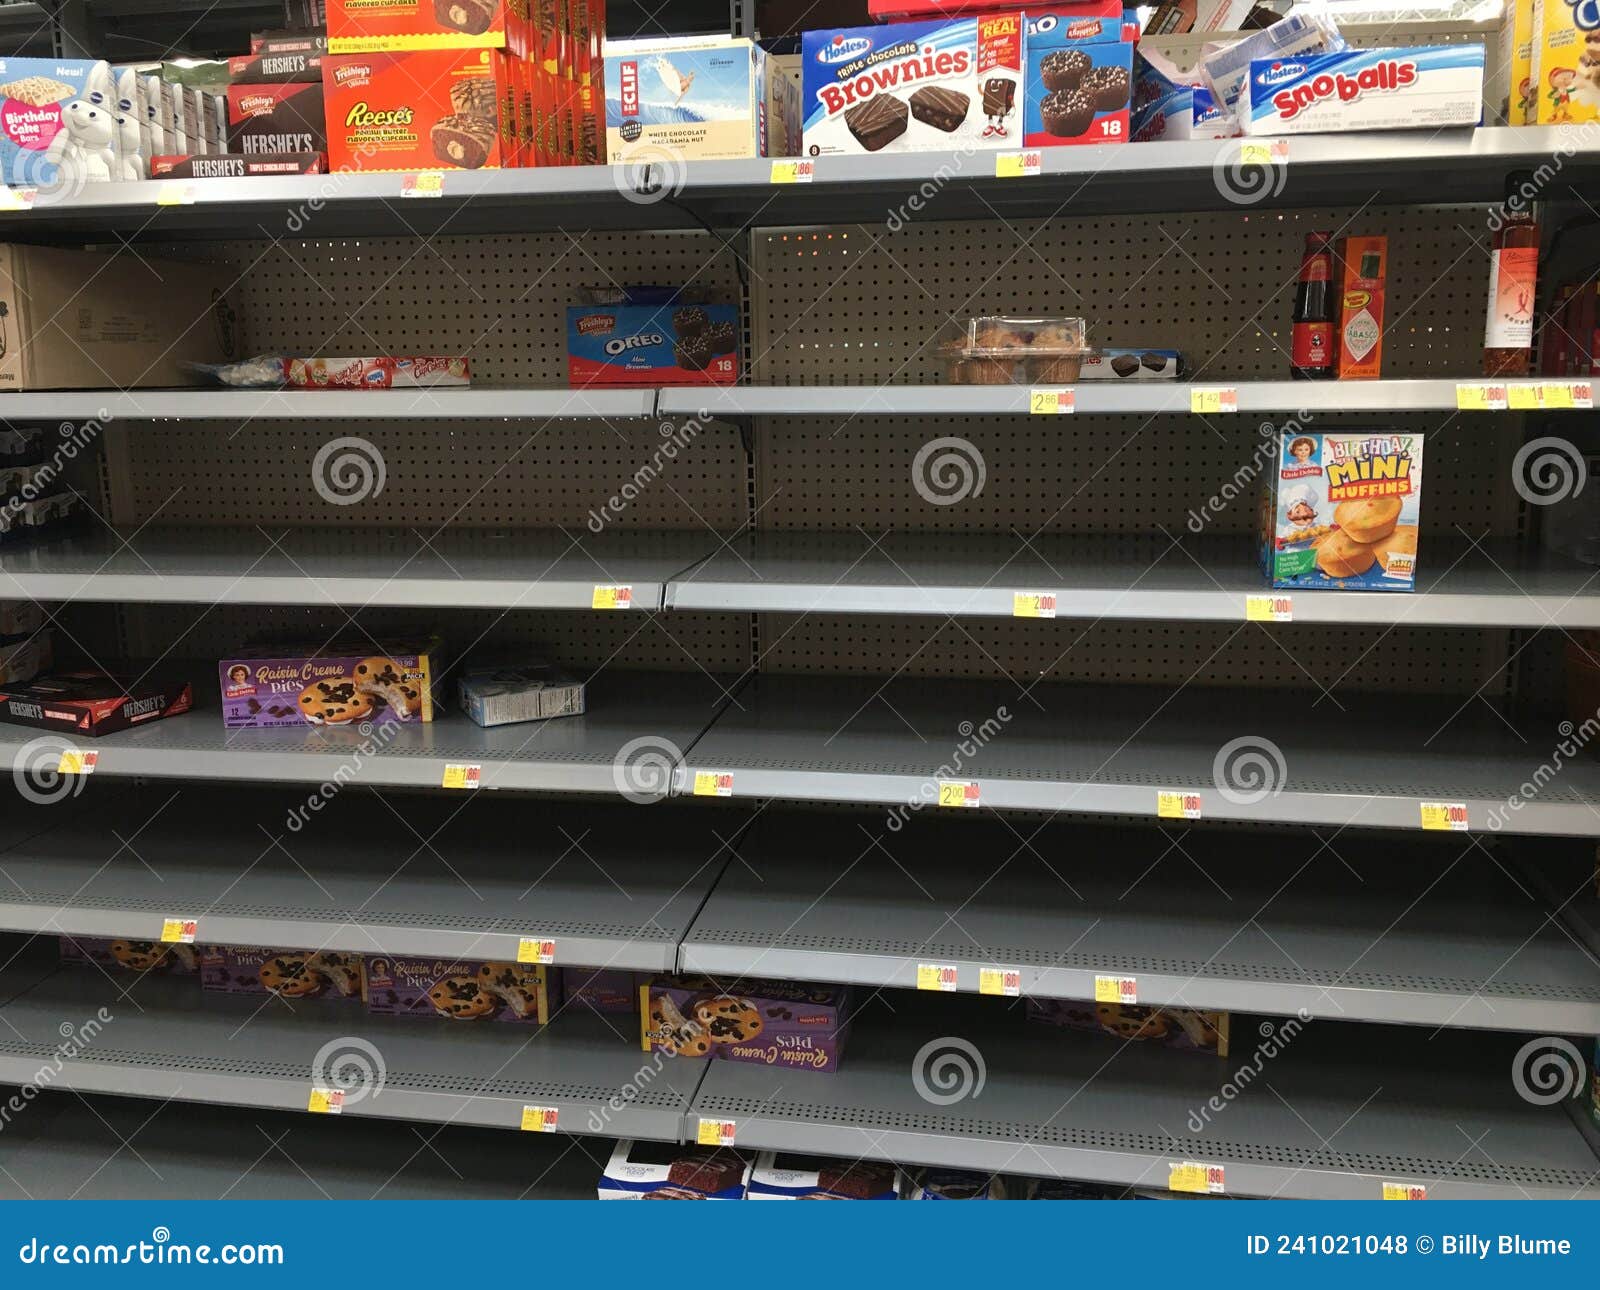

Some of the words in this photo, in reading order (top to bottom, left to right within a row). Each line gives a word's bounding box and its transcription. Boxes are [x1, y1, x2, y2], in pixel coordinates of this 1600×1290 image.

[984, 21, 1018, 37] REAL
[480, 51, 490, 64] 6
[825, 39, 868, 61] Hostess
[56, 67, 83, 76] New!
[262, 56, 305, 75] HERSHEY'S
[1263, 64, 1303, 83] Hostess
[820, 47, 968, 115] Brownies
[5, 110, 59, 124] Birthday
[346, 102, 414, 127] Reese's
[10, 123, 39, 134] Cake
[1101, 120, 1121, 135] 18
[242, 133, 312, 154] HERSHEY'S
[192, 159, 244, 177] HERSHEY'S
[605, 334, 663, 355] OREO
[717, 360, 732, 371] 18
[1332, 480, 1409, 499] MUFFINS
[256, 666, 299, 684] Raisin
[302, 663, 344, 680] Creme
[124, 695, 166, 718] HERSHEY'S
[732, 1046, 777, 1063] Creme
[781, 1048, 828, 1068] Raisin
